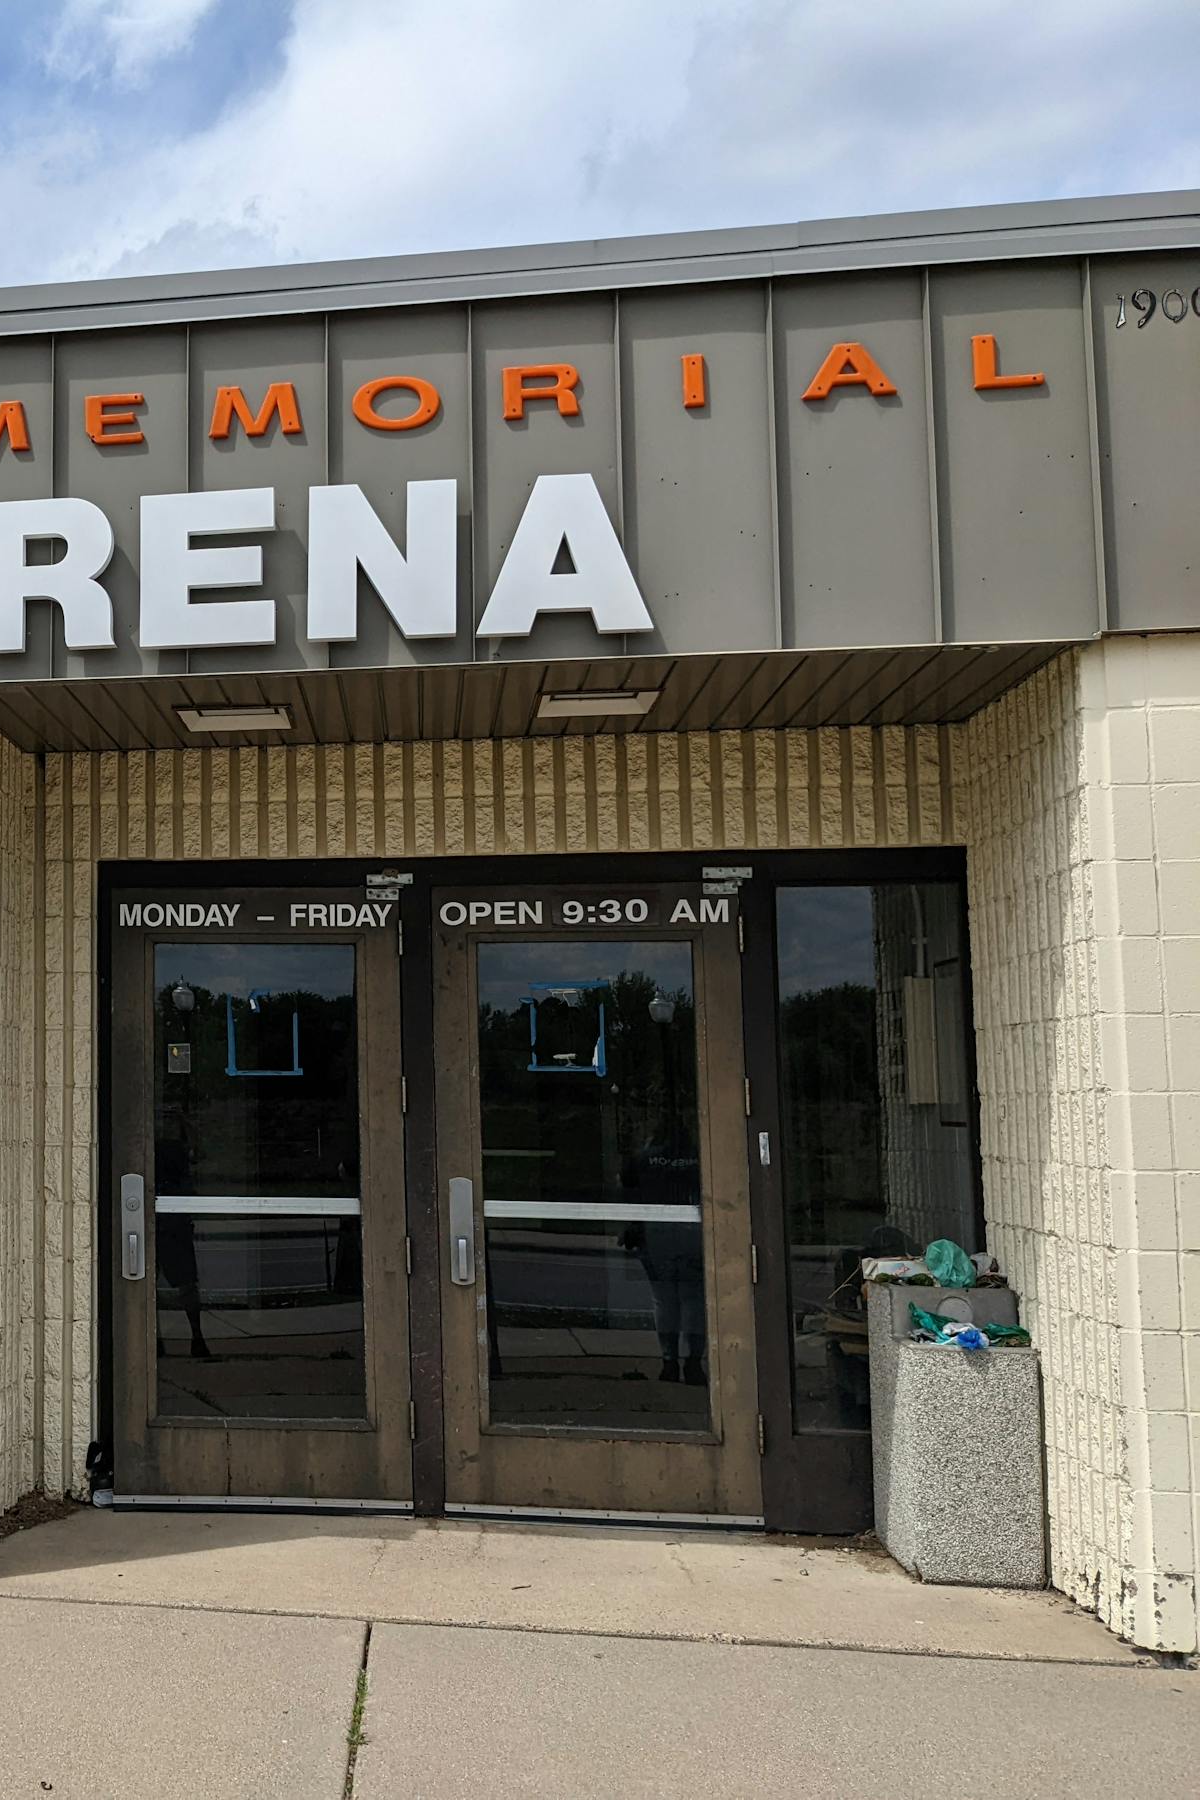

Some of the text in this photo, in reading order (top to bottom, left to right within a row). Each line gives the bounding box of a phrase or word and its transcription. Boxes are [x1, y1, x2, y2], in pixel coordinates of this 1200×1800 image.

[119, 903, 240, 927] MONDAY
[289, 903, 393, 927] FRIDAY
[439, 898, 730, 926] OPEN 9:30 AM
